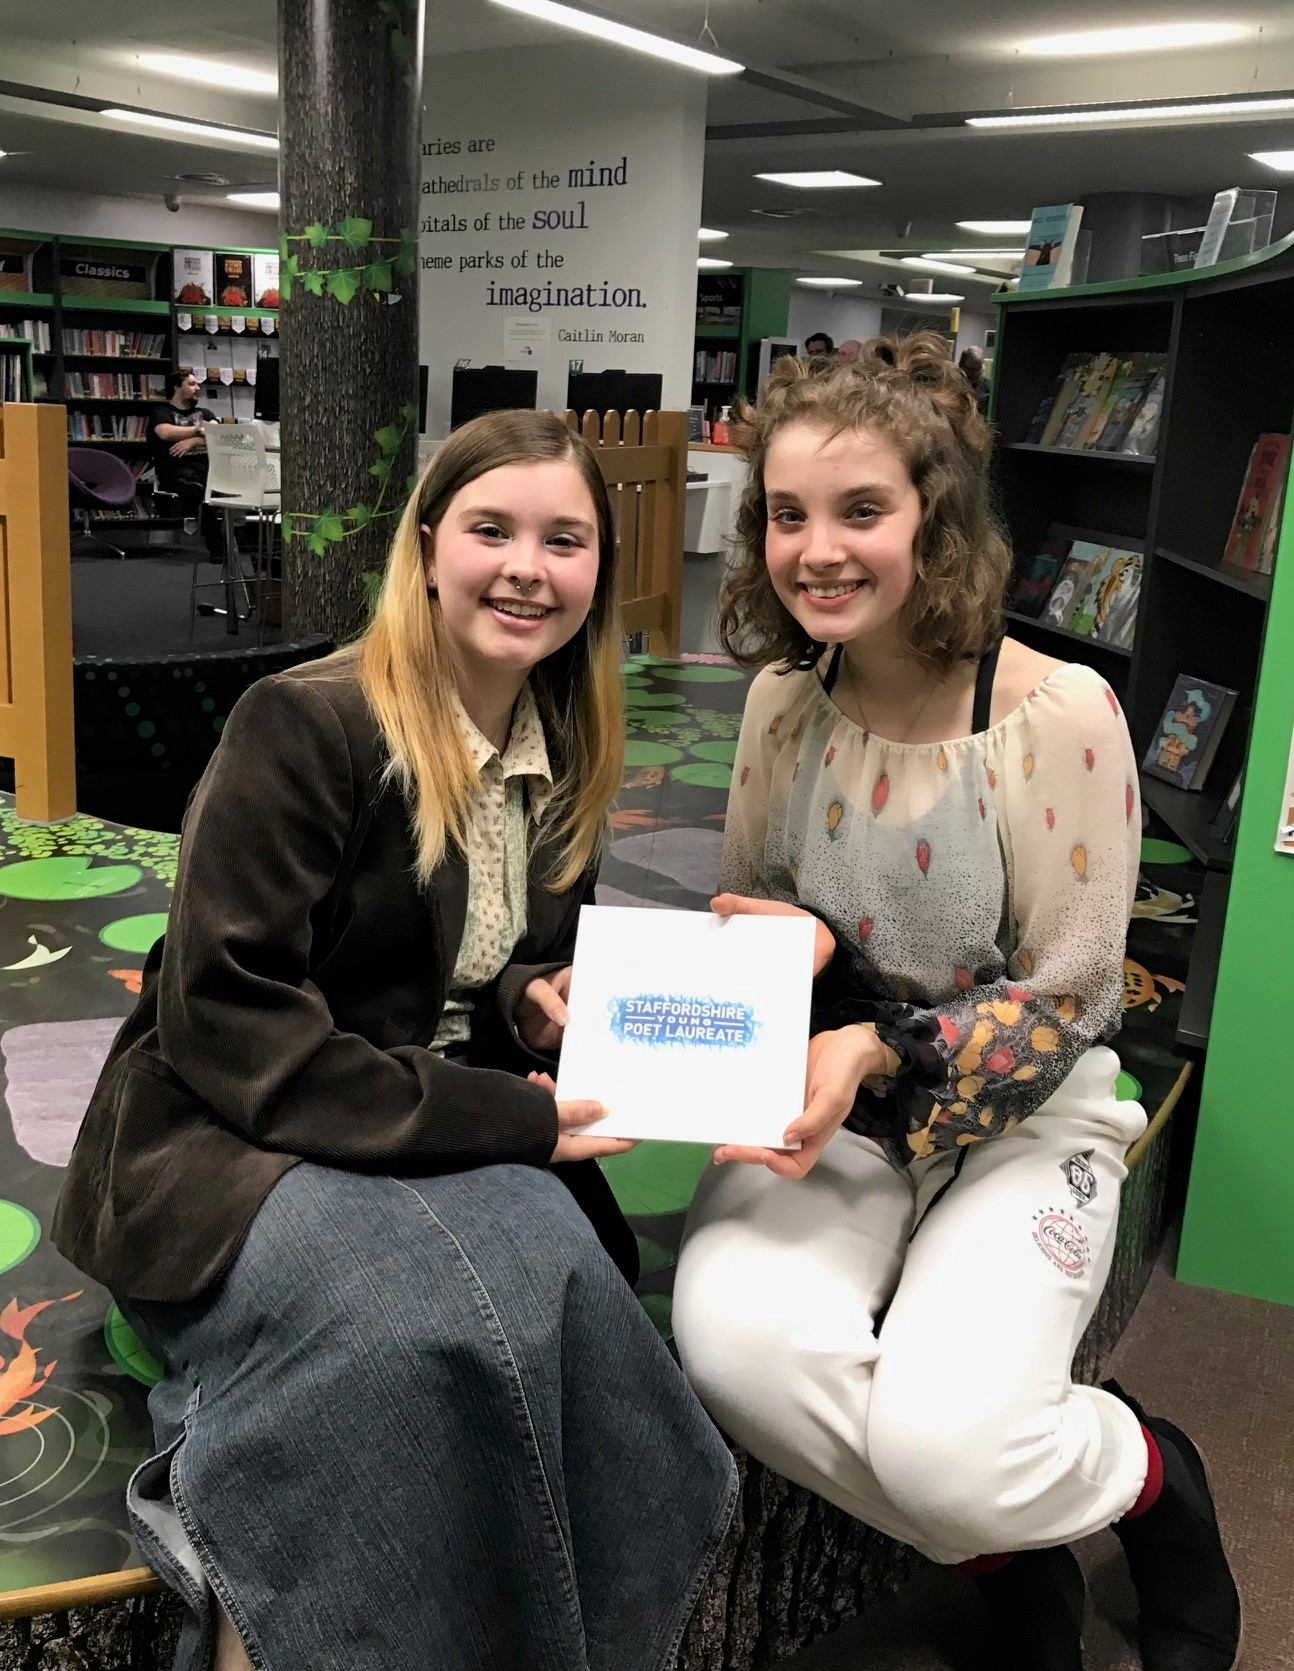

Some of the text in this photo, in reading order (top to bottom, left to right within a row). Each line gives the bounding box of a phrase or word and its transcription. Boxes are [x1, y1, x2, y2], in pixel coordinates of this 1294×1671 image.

[467, 138, 496, 153] are
[422, 156, 628, 195] athedrals of the mind
[473, 212, 491, 232] of
[499, 212, 526, 231] the
[532, 201, 589, 230] soul
[459, 250, 504, 273] parks
[510, 249, 529, 269] of
[536, 249, 564, 268] the
[75, 263, 131, 280] Classics
[485, 280, 647, 312] imagination.
[700, 293, 723, 304] Sports
[558, 328, 604, 343] Caitlin
[608, 330, 645, 343] Moran
[258, 349, 268, 359] 14
[457, 359, 470, 368] 16
[570, 360, 582, 371] 17
[625, 1000, 746, 1021] STAFFORDSHIRE
[656, 1015, 712, 1027] YOUNG
[623, 1022, 744, 1043] POET LAUREATE
